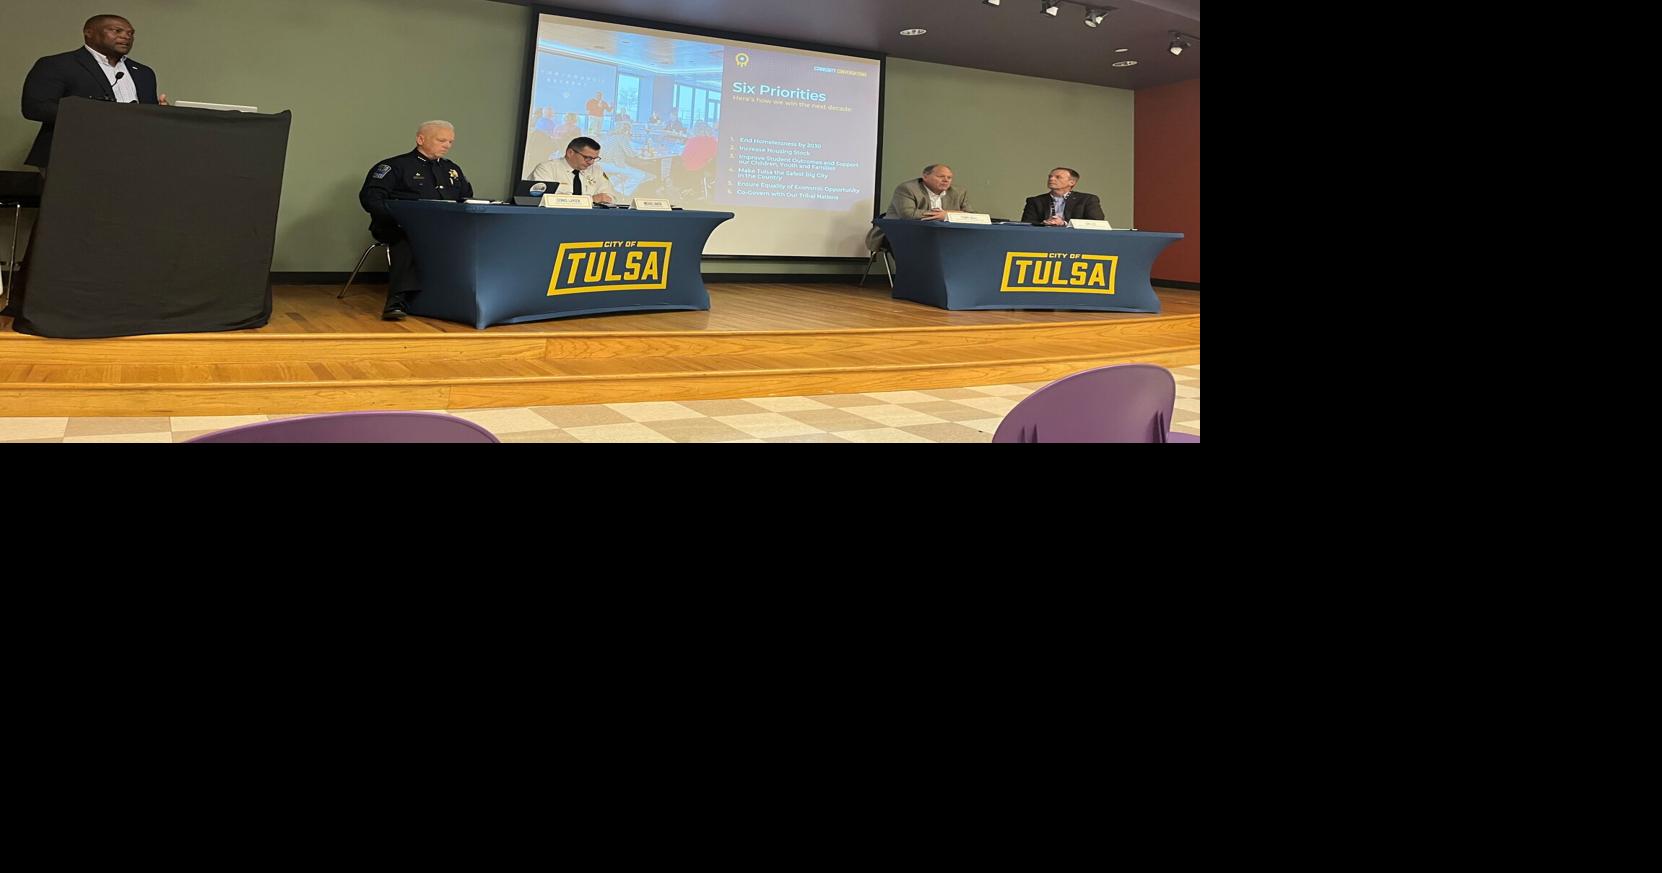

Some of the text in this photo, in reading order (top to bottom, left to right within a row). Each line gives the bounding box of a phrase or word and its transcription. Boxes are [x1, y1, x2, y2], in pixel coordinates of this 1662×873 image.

[732, 82, 826, 102] Six Priorities
[754, 138, 797, 147] Homelessness
[824, 186, 860, 194] Opportunity
[568, 251, 658, 284] TULSA
[1016, 260, 1106, 286] TULSA
